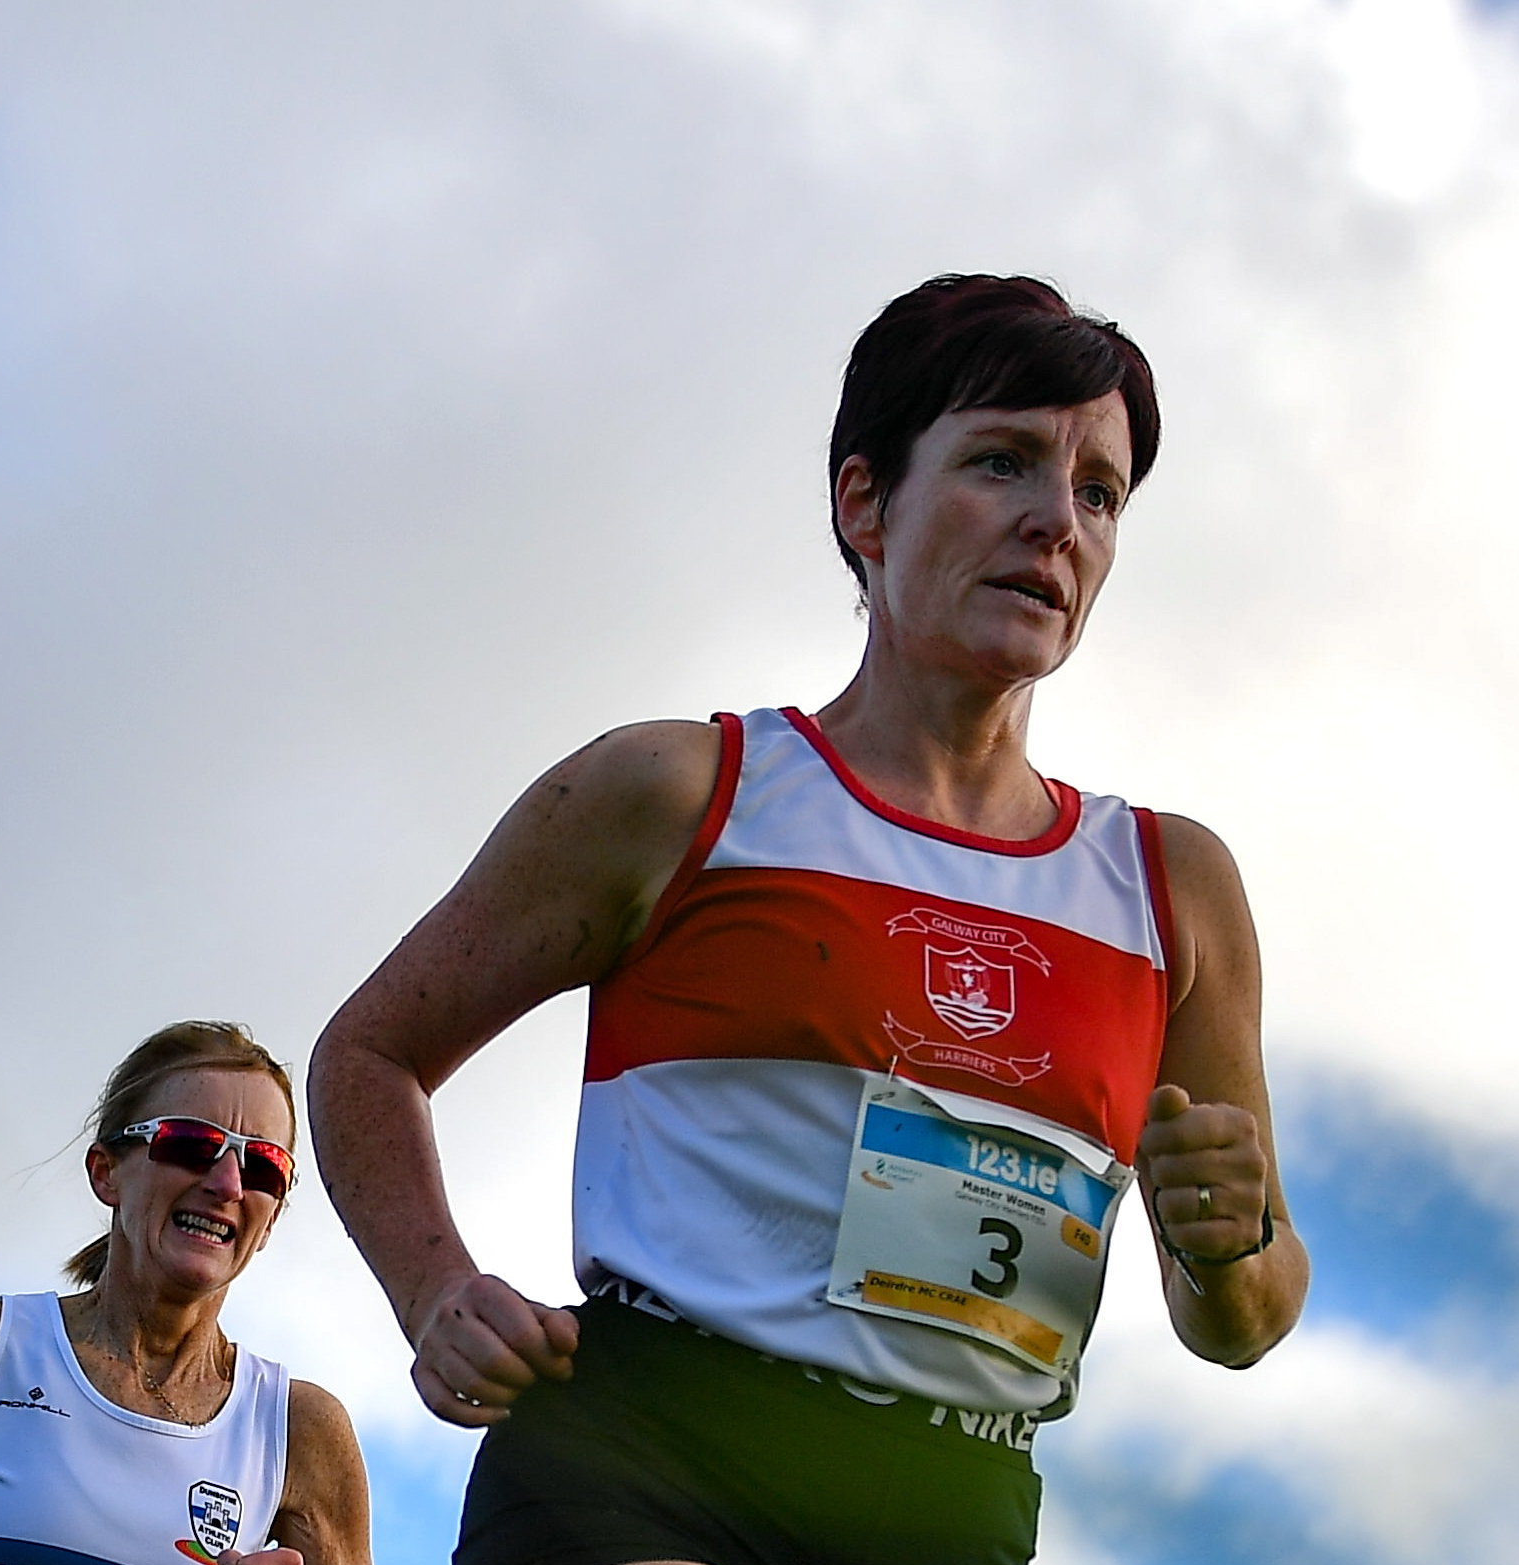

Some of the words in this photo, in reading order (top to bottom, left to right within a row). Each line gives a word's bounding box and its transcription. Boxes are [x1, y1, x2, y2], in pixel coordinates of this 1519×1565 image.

[932, 917, 980, 940] GALWAY
[982, 931, 1007, 944] CITY
[934, 1049, 997, 1074] HARRIERS
[966, 1133, 1060, 1196] 123.ie
[962, 1179, 1003, 1201] Master
[1006, 1191, 1046, 1217] Women
[971, 1216, 1024, 1300] 3
[869, 1276, 916, 1295] Deirdre
[918, 1286, 937, 1300] MC
[199, 1486, 237, 1506] DUNBOYNE
[198, 1524, 231, 1544] ATHLETIC
